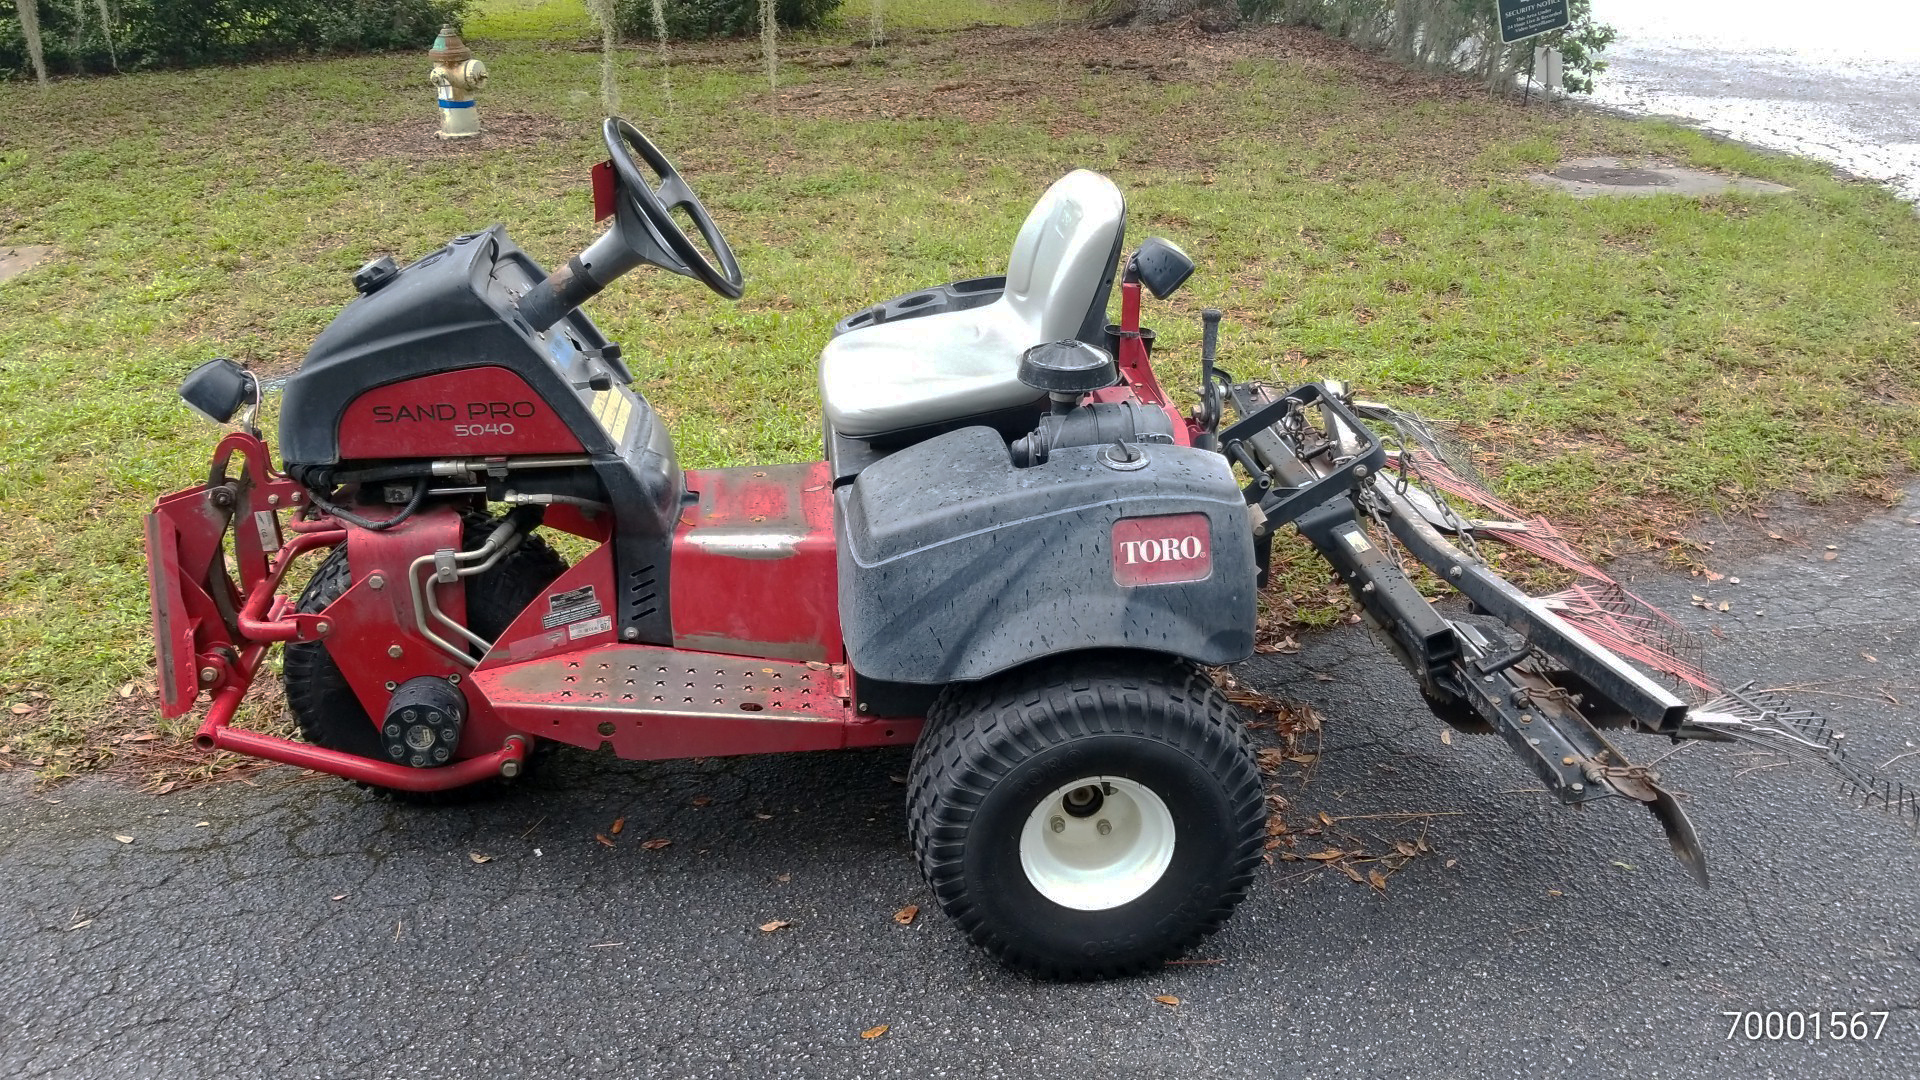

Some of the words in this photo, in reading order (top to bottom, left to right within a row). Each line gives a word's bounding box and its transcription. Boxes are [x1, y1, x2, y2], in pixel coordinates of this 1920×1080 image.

[1505, 4, 1535, 18] SECURITY
[1541, 10, 1562, 19] Recorded
[1529, 18, 1555, 28] Surveillance
[372, 403, 456, 423] SAND
[468, 401, 535, 420] PRO
[454, 423, 515, 437] 5040
